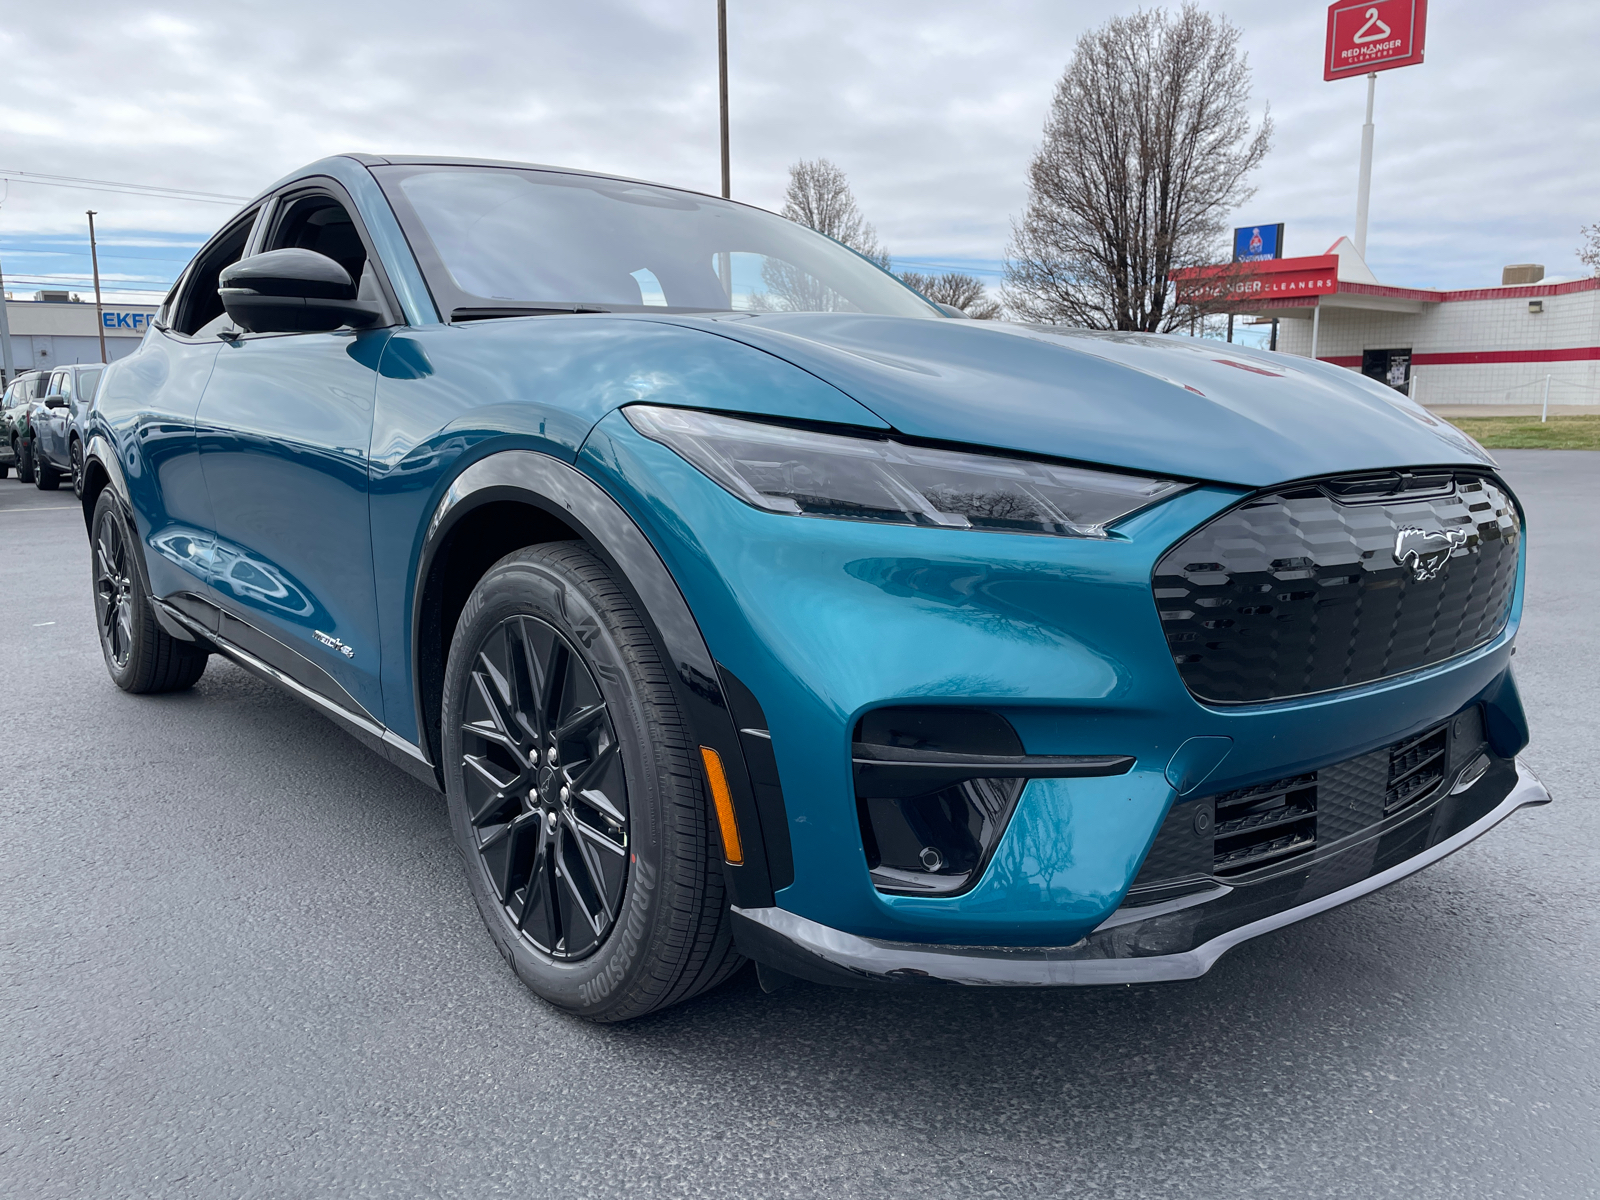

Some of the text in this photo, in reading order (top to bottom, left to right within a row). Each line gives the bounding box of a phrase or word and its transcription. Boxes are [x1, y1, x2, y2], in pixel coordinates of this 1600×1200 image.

[1342, 39, 1401, 58] RED HANGER
[1349, 49, 1393, 63] CLEANERS
[1264, 279, 1332, 292] CLEANERS
[578, 852, 657, 1008] BRIDGESTONE
